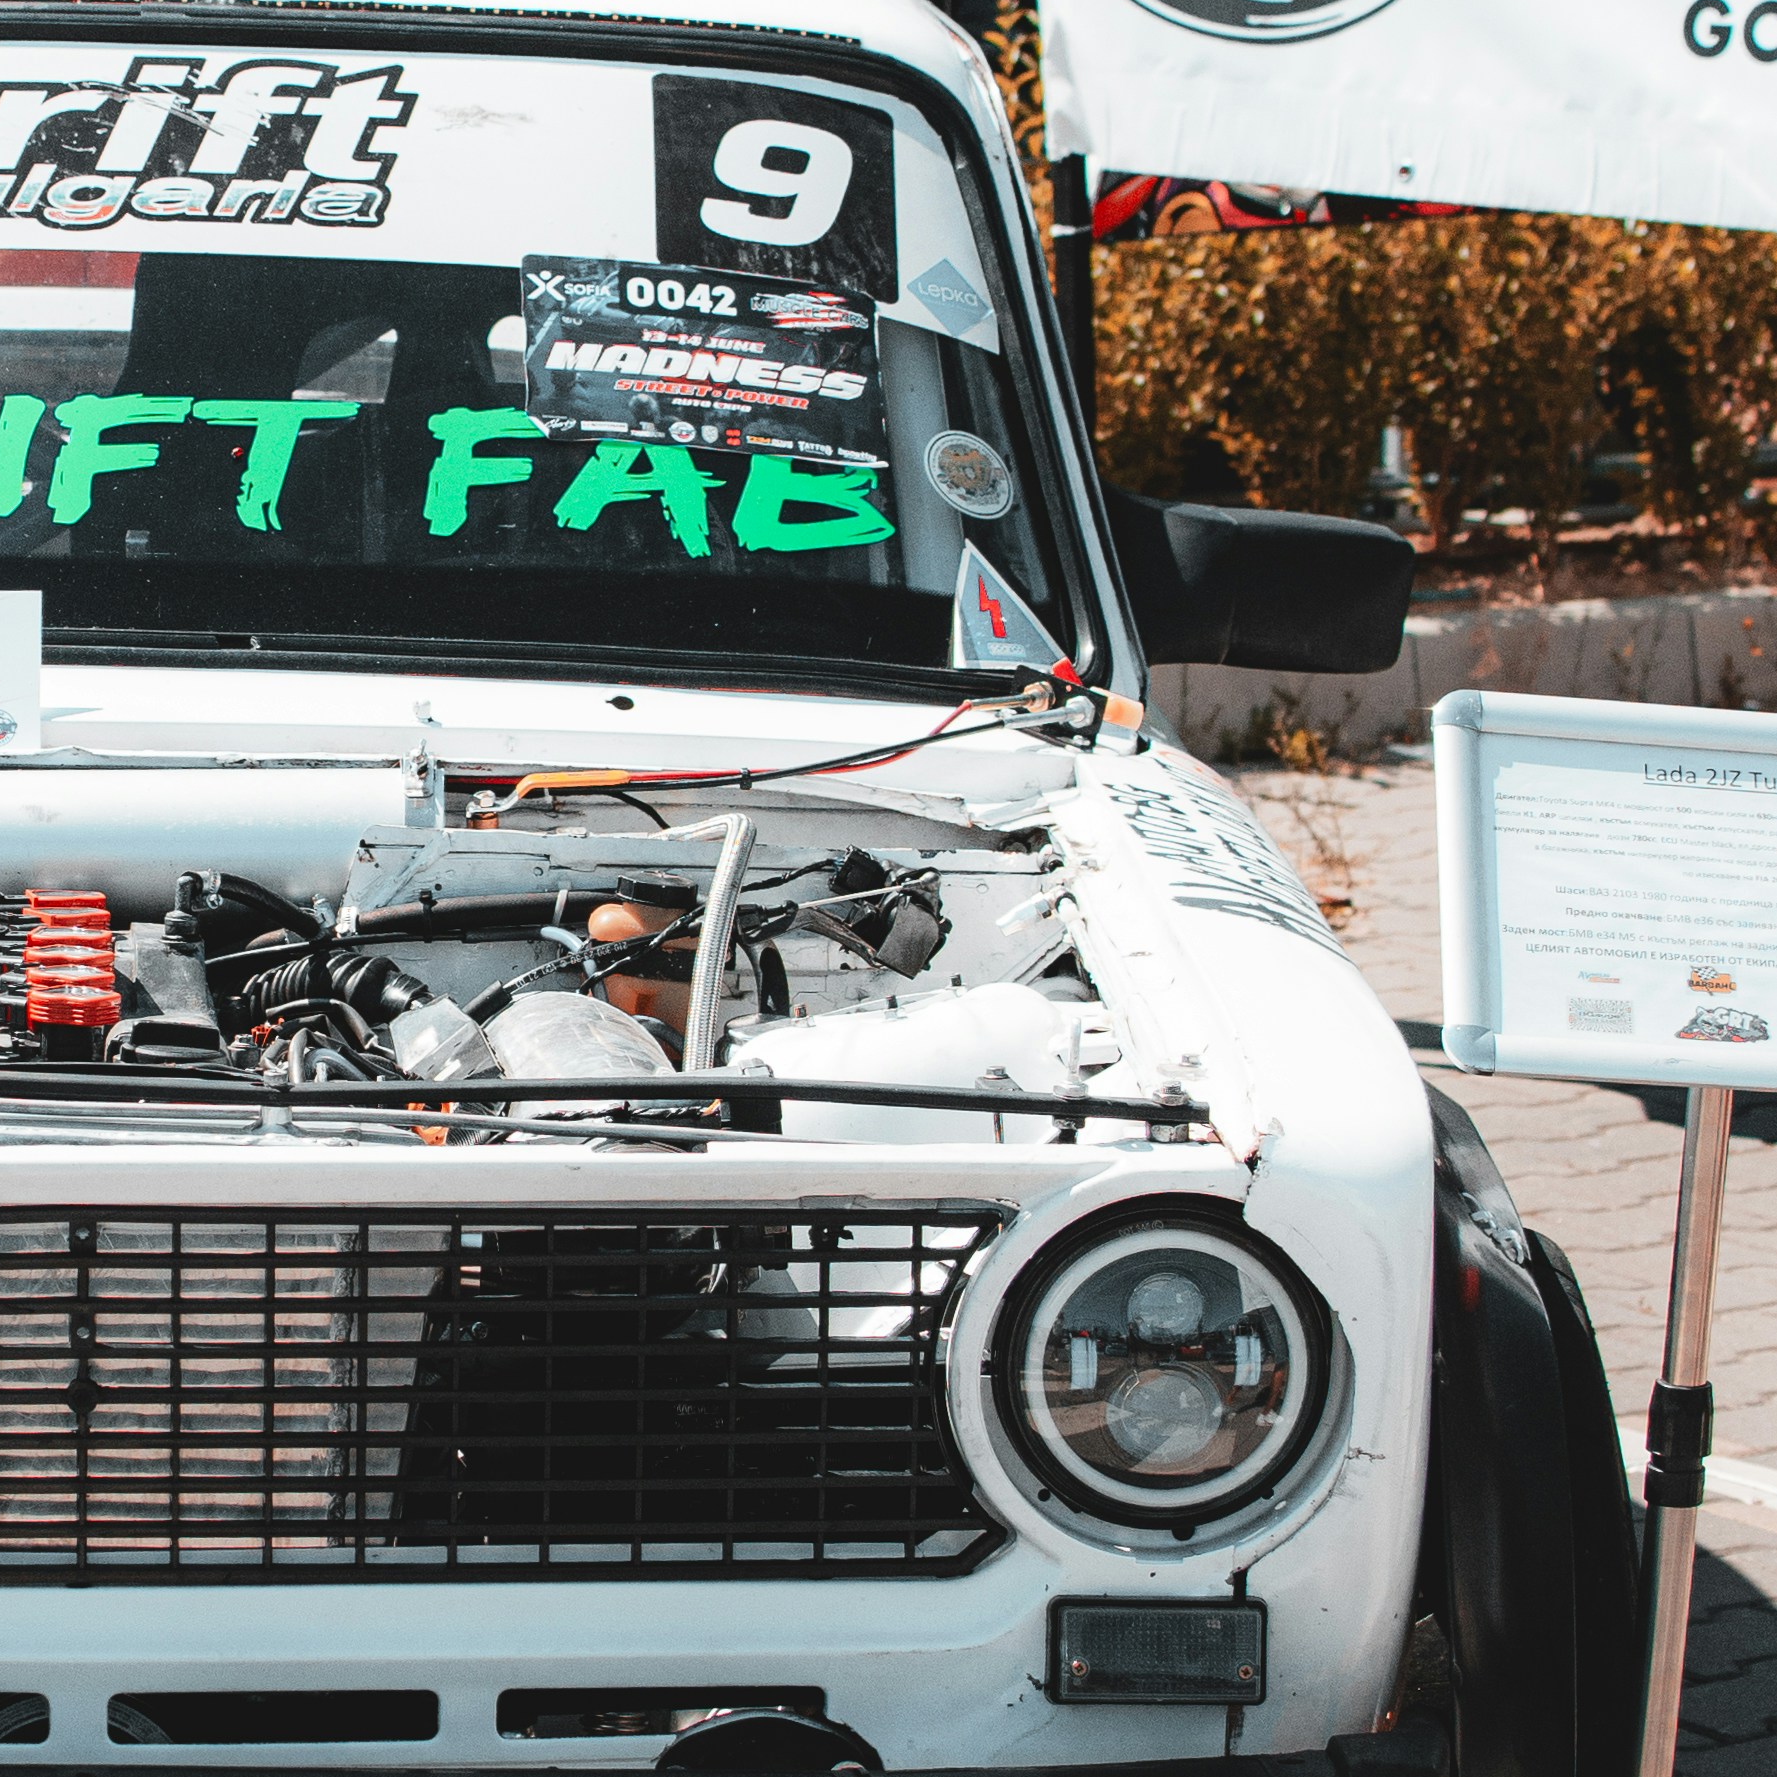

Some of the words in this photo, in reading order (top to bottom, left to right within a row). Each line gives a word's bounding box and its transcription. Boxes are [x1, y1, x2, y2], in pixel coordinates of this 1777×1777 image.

[699, 119, 853, 247] 9
[564, 282, 611, 297] SOFIA
[626, 276, 738, 317] 0042
[705, 335, 767, 354] JUNE
[545, 339, 868, 401] MADNESS
[422, 406, 896, 558] FAB
[1644, 763, 1697, 784] Lada
[1705, 768, 1743, 787] 2JZ
[1570, 798, 1594, 807] Supra
[1641, 891, 1668, 903] 1980
[1669, 895, 1709, 906] година
[1565, 907, 1609, 919] Предно
[1502, 924, 1536, 935] Заден
[1646, 935, 1687, 945] къстъм
[1525, 942, 1571, 954] ЦЕЛИЯТ
[1573, 946, 1647, 960] АВТОМОБИЛ
[1659, 952, 1726, 965] ИЗРАБОТЕН
[1728, 956, 1743, 965] ОТ
